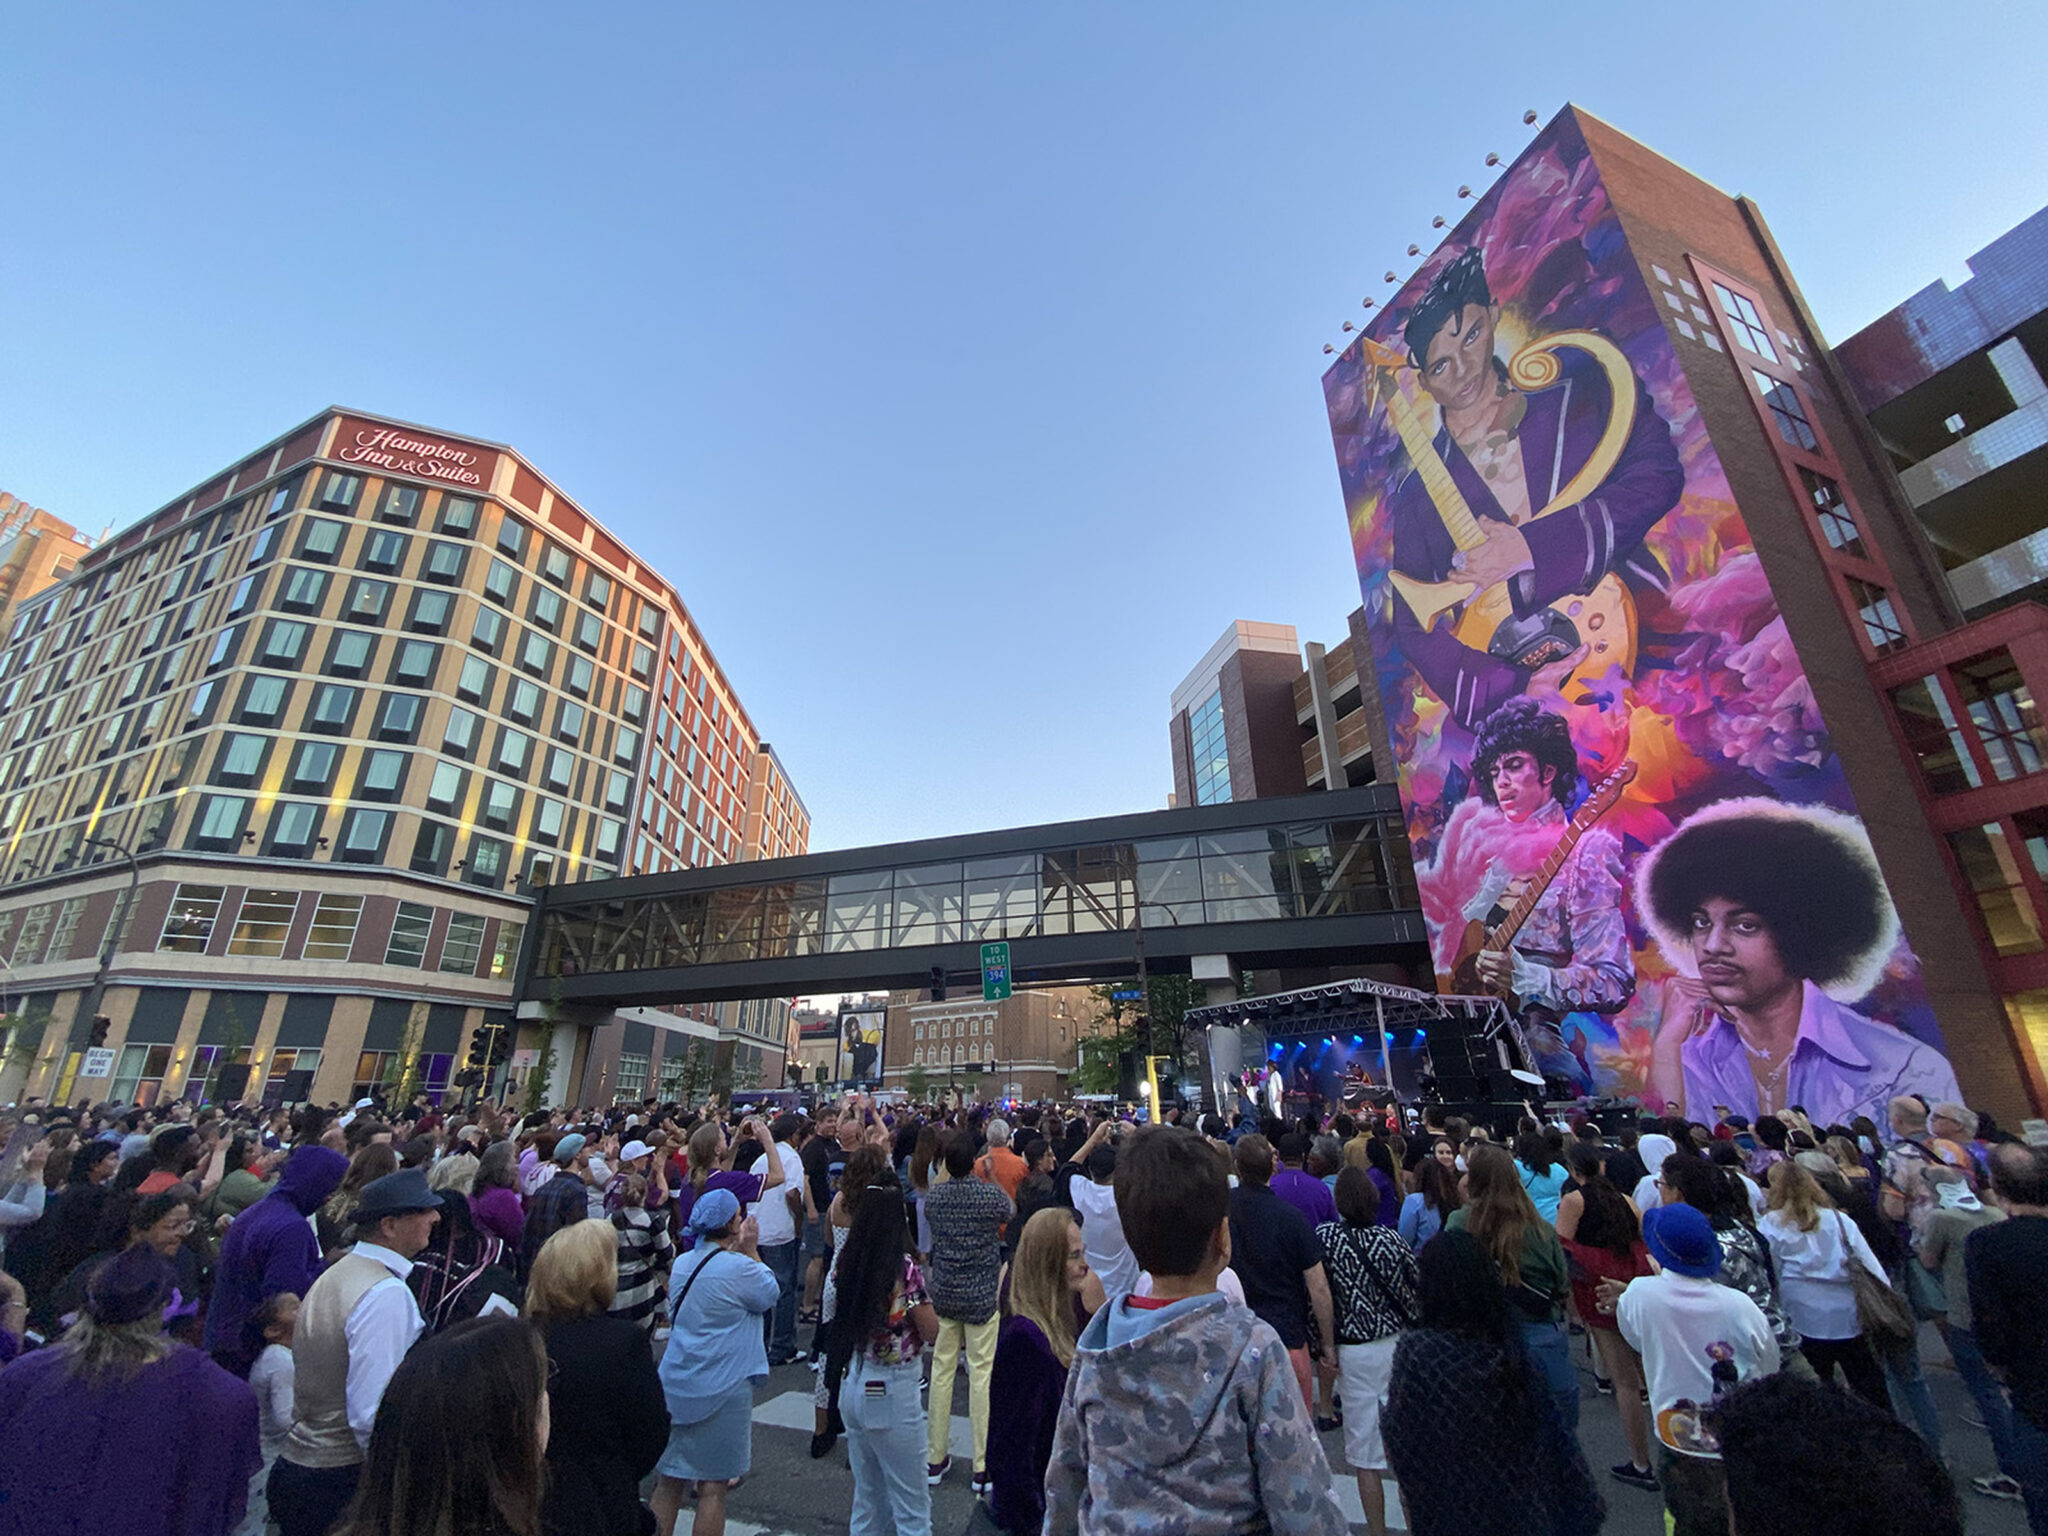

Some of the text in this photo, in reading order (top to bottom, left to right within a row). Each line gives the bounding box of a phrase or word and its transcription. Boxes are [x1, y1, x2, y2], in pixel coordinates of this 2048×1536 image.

[356, 429, 477, 466] Hampton
[340, 447, 480, 485] Inn & Suites
[989, 945, 1000, 955] TO
[984, 955, 1006, 964] WEST
[989, 970, 1004, 981] 394
[89, 1050, 113, 1058] BEGIN
